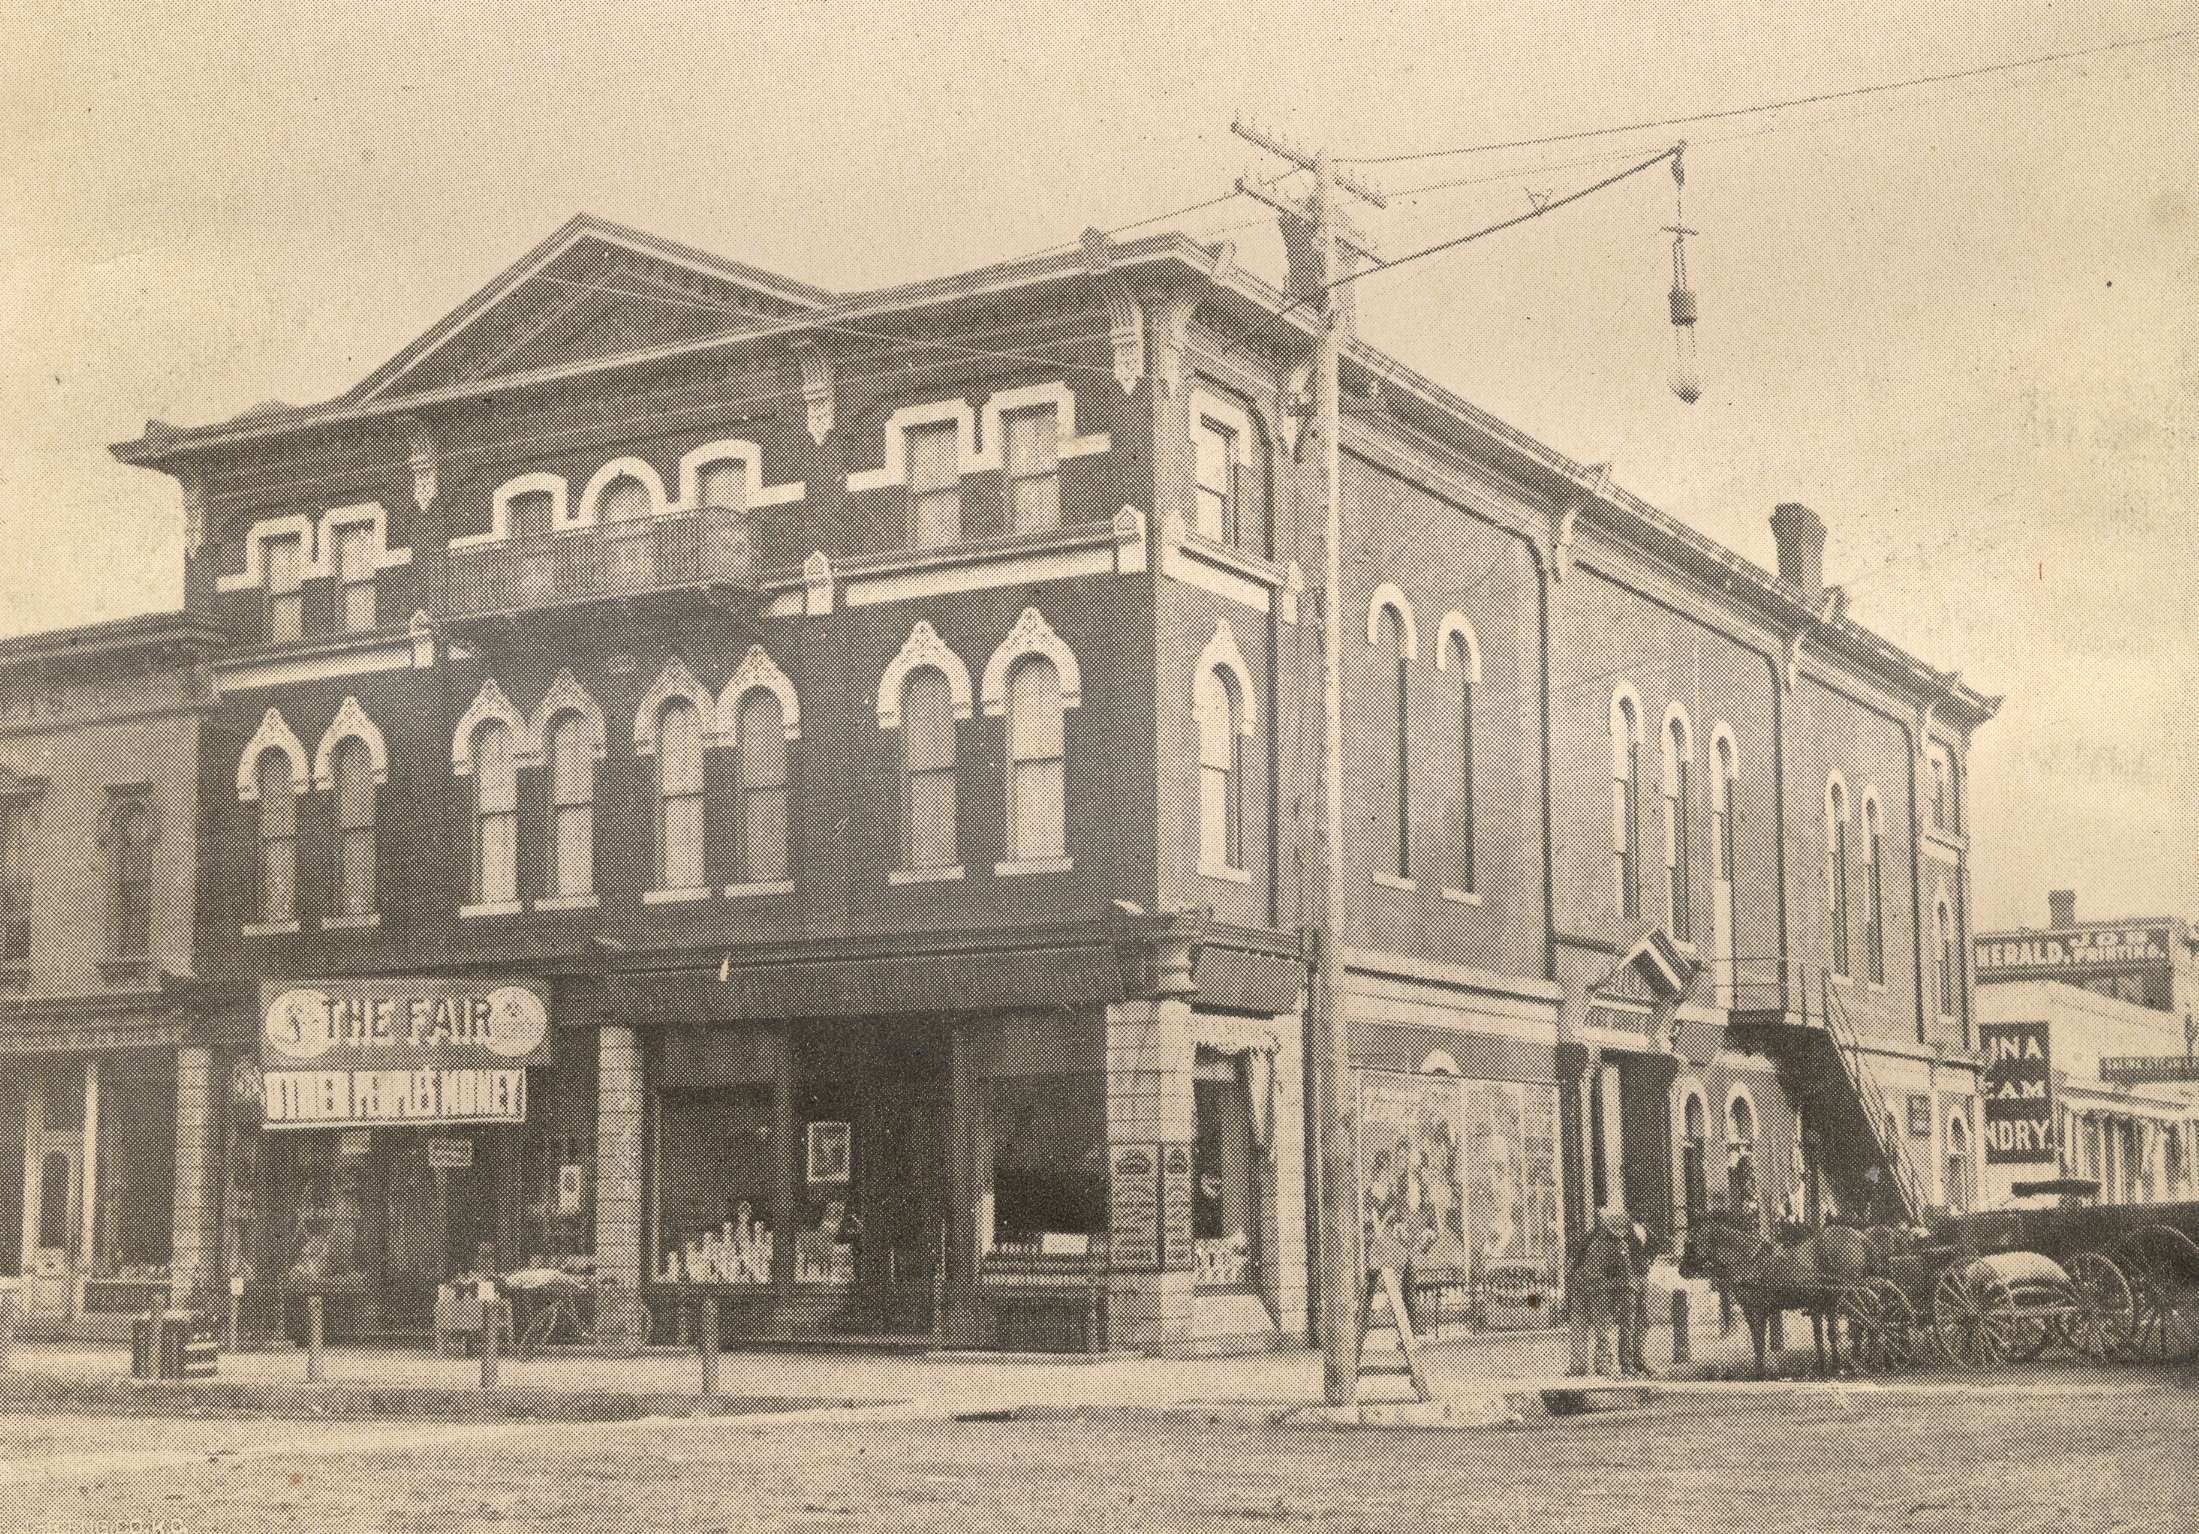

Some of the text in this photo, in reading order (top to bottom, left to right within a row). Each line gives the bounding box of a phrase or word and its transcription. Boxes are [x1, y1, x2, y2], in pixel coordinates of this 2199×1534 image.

[1976, 941, 2070, 968] HERALD,
[322, 997, 494, 1045] THE FAIR
[441, 1070, 518, 1116] MONEY
